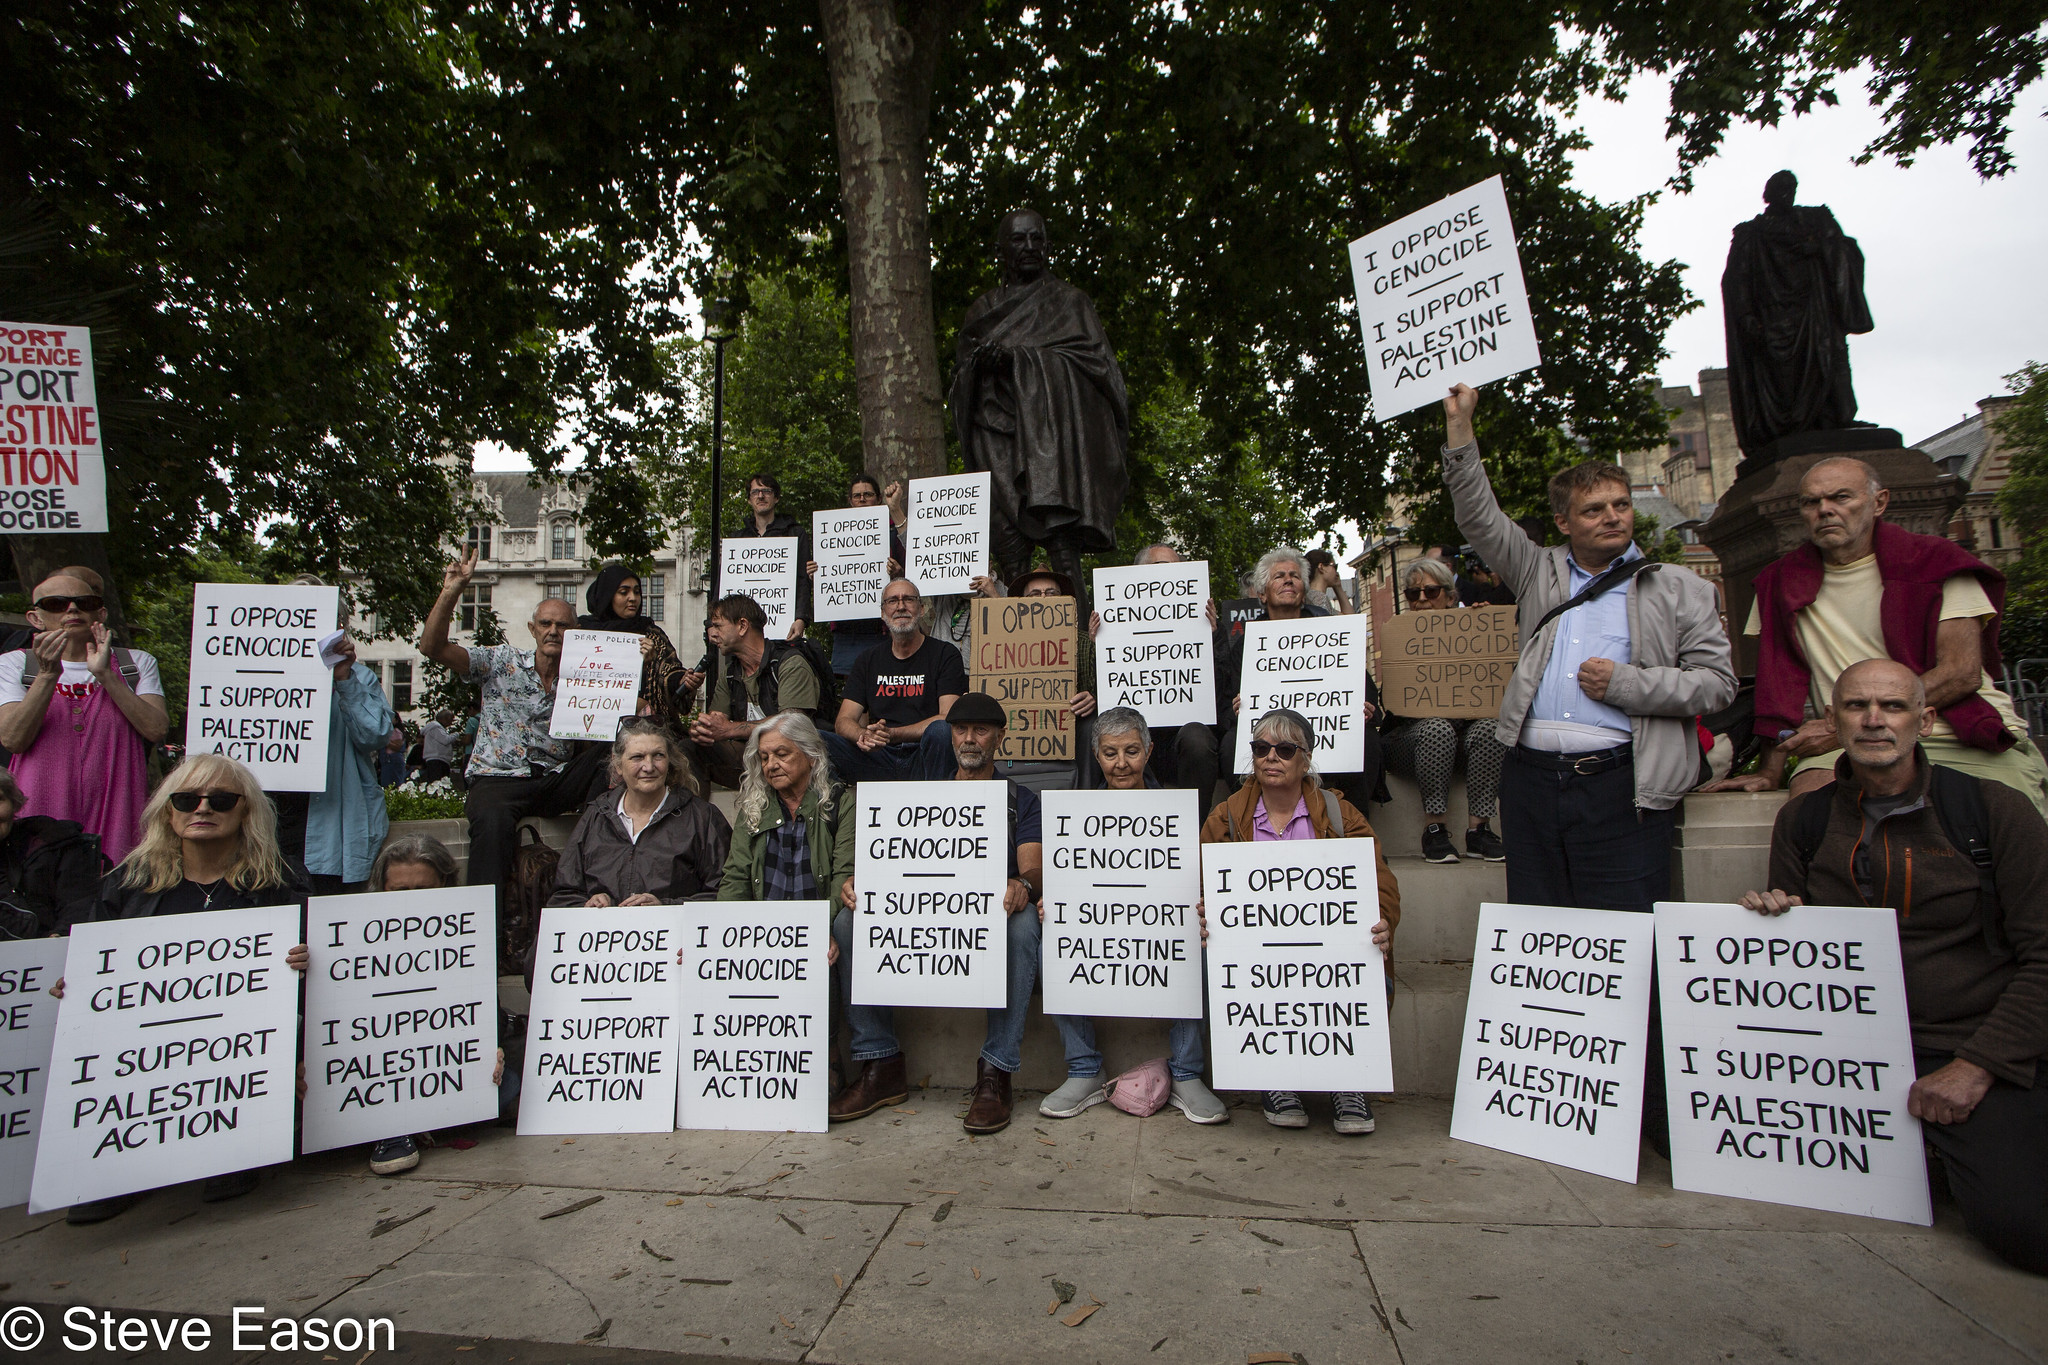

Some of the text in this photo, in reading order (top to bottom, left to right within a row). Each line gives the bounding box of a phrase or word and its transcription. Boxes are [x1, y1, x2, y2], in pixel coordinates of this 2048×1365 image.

[1364, 204, 1483, 273] I OPPOSE
[1374, 229, 1492, 295] GENOCIDE
[1373, 272, 1504, 344] I SUPPORT
[1381, 303, 1512, 370] PALESTINE
[1394, 332, 1497, 389] ACTION
[916, 485, 981, 503] I OPPOSE
[917, 503, 977, 520] GENOCIDE
[821, 518, 879, 534] I OPPOSE
[820, 534, 881, 550] GENOCIDE
[912, 532, 980, 549] I SUPPORT
[728, 548, 789, 560] I OPPOSE
[914, 550, 979, 567] PALESTINE
[727, 563, 786, 574] GENOCIDE
[820, 561, 884, 577] I SUPPORT
[919, 565, 970, 580] ACTION
[820, 578, 883, 594] PALESTINE
[1105, 579, 1198, 601] I OPPOSE
[827, 592, 877, 606] ACTION
[206, 606, 317, 629] I OPPOSE
[982, 602, 1074, 635] I OPPOSE
[1103, 602, 1198, 623] GENOCIDE
[1415, 612, 1506, 633] OPPOSE
[205, 636, 316, 658] GENOCIDE
[1106, 642, 1204, 663] I SUPPORT
[1257, 632, 1351, 652] I OPPOSE
[1405, 633, 1519, 656] GENOCIDE
[579, 657, 613, 670] LOVE
[981, 638, 1069, 671] GENOCIDE
[1256, 653, 1349, 672] GENOCIDE
[876, 674, 925, 685] PALESTINE
[996, 678, 1073, 701] SUPPORT
[1108, 668, 1201, 688] PALESTINE
[199, 686, 317, 709] I SUPPORT
[875, 684, 924, 697] ACTION
[1118, 687, 1194, 706] ACTION
[1249, 691, 1354, 710] I SUPPORT
[202, 718, 314, 740] PALESTINE
[1004, 709, 1069, 731] ESTINE
[212, 742, 300, 763] ACTION
[868, 805, 986, 828] I OPPOSE
[1056, 815, 1179, 837] I OPPOSE
[870, 837, 988, 860] GENOCIDE
[1053, 847, 1182, 870] GENOCIDE
[1217, 865, 1357, 893] I OPPOSE
[863, 891, 995, 916] I SUPPORT
[1054, 902, 1190, 927] I SUPPORT
[1220, 901, 1358, 928] GENOCIDE
[328, 912, 476, 947] I OPPOSE
[553, 929, 669, 953] I OPPOSE
[696, 925, 809, 948] I OPPOSE
[869, 926, 989, 951] PALESTINE
[96, 932, 273, 975] I OPPOSE
[1058, 937, 1187, 961] PALESTINE
[1491, 929, 1627, 964] I OPPOSE
[1678, 935, 1865, 972] I OPPOSE
[330, 944, 476, 981] GENOCIDE
[550, 961, 668, 985] GENOCIDE
[698, 958, 808, 981] GENOCIDE
[877, 953, 970, 976] ACTION
[1069, 963, 1169, 988] ACTION
[1221, 963, 1367, 989] I SUPPORT
[1490, 963, 1622, 1000] GENOCIDE
[90, 967, 270, 1012] GENOCIDE
[1686, 976, 1877, 1015] GENOCIDE
[322, 1001, 482, 1046] I SUPPORT
[693, 1013, 812, 1038] I SUPPORT
[1226, 1002, 1370, 1028] PALESTINE
[538, 1016, 670, 1041] I SUPPORT
[1240, 1030, 1355, 1056] ACTION
[1476, 1019, 1627, 1065] I SUPPORT
[71, 1054, 100, 1086] I
[114, 1028, 277, 1077] SUPPORT
[326, 1039, 481, 1085] PALESTINE
[538, 1051, 662, 1076] PALESTINE
[693, 1049, 813, 1074] PALESTINE
[1679, 1046, 1889, 1092] I SUPPORT
[339, 1069, 463, 1112] ACTION
[547, 1078, 643, 1103] ACTION
[702, 1076, 798, 1100] ACTION
[1476, 1056, 1620, 1108] PALESTINE
[73, 1070, 269, 1129] PALESTINE
[1485, 1089, 1598, 1136] ACTION
[1690, 1090, 1894, 1141] PALESTINE
[92, 1106, 238, 1159] ACTION
[1716, 1128, 1870, 1174] ACTION
